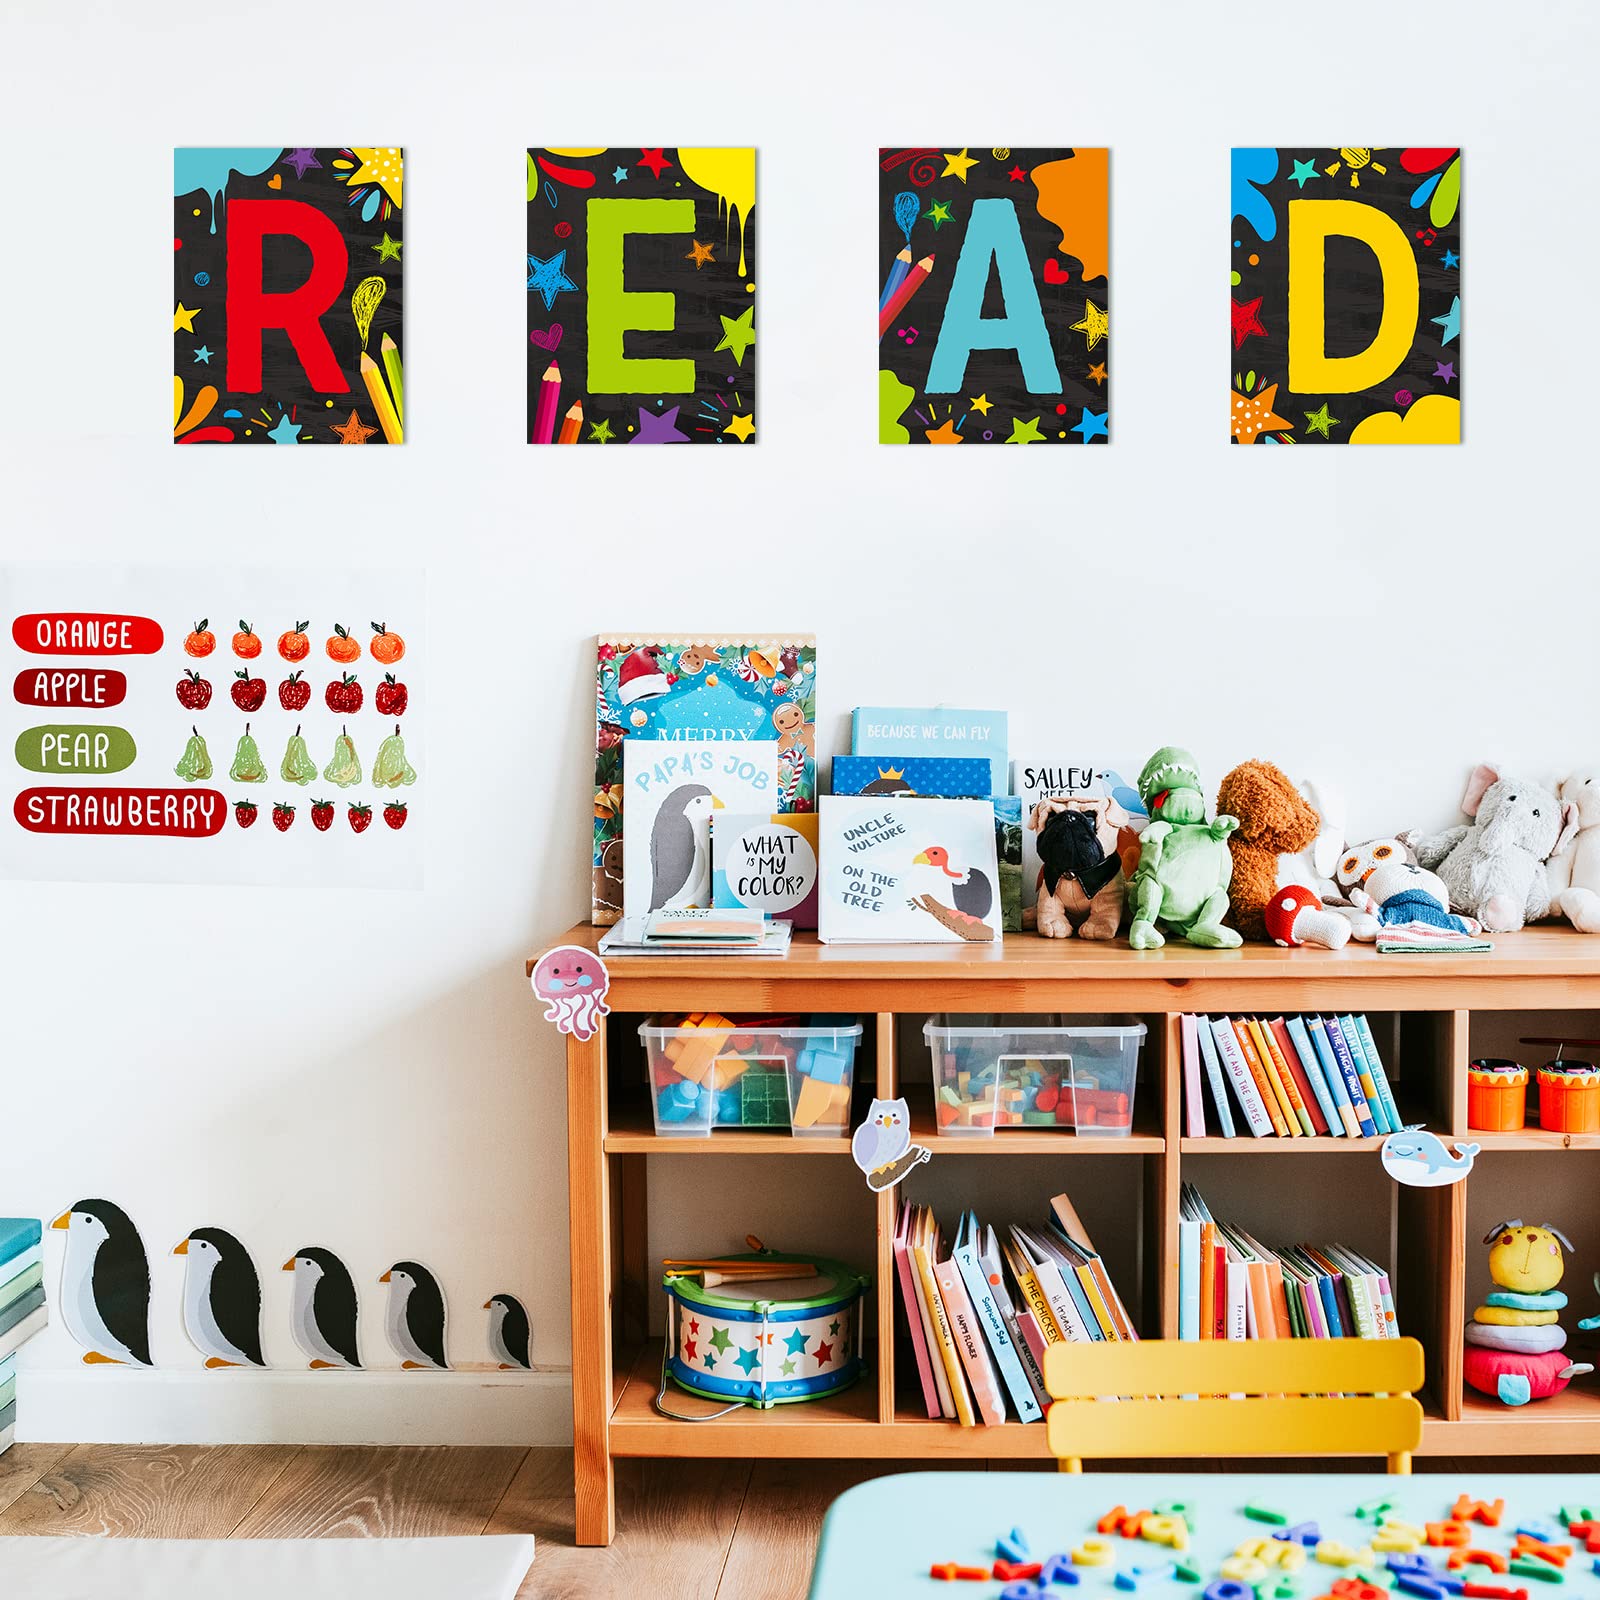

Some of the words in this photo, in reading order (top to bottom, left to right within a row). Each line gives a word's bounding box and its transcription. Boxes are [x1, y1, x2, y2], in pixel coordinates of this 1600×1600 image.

[226, 198, 351, 394] R
[586, 198, 696, 394] E
[924, 198, 1063, 394] A
[1288, 198, 1420, 394] D
[36, 620, 132, 649] ORANGE
[34, 672, 106, 704] APPLE
[867, 724, 917, 739] BECAUSE
[921, 725, 939, 740] WE
[943, 726, 966, 740] CAN
[970, 726, 991, 741] FLY
[41, 733, 110, 769] PEAR
[635, 751, 714, 793] PAPA'S
[723, 755, 770, 790] JOB
[1024, 767, 1093, 789] SALLEY
[27, 795, 216, 830] STRAWBERRY
[843, 812, 896, 842] UNCLE
[742, 835, 799, 855] WHAT
[847, 823, 907, 853] VULTURE
[758, 855, 786, 875] MY
[842, 865, 864, 878] ON
[870, 871, 899, 888] THE
[738, 875, 804, 897] COLOR?
[849, 881, 882, 898] OLD
[841, 891, 884, 912] TREE
[1341, 1019, 1361, 1058] SUMMER
[1217, 1032, 1237, 1057] JENNY
[1230, 1060, 1244, 1077] AND
[1238, 1079, 1252, 1096] THE
[1245, 1097, 1263, 1125] HORSE
[1337, 1046, 1353, 1074] MAGIC
[1346, 1074, 1362, 1099] NIGHT
[1026, 1278, 1041, 1300] THE
[1034, 1300, 1060, 1343] CHICKEN
[963, 1334, 978, 1360] FLOWER
